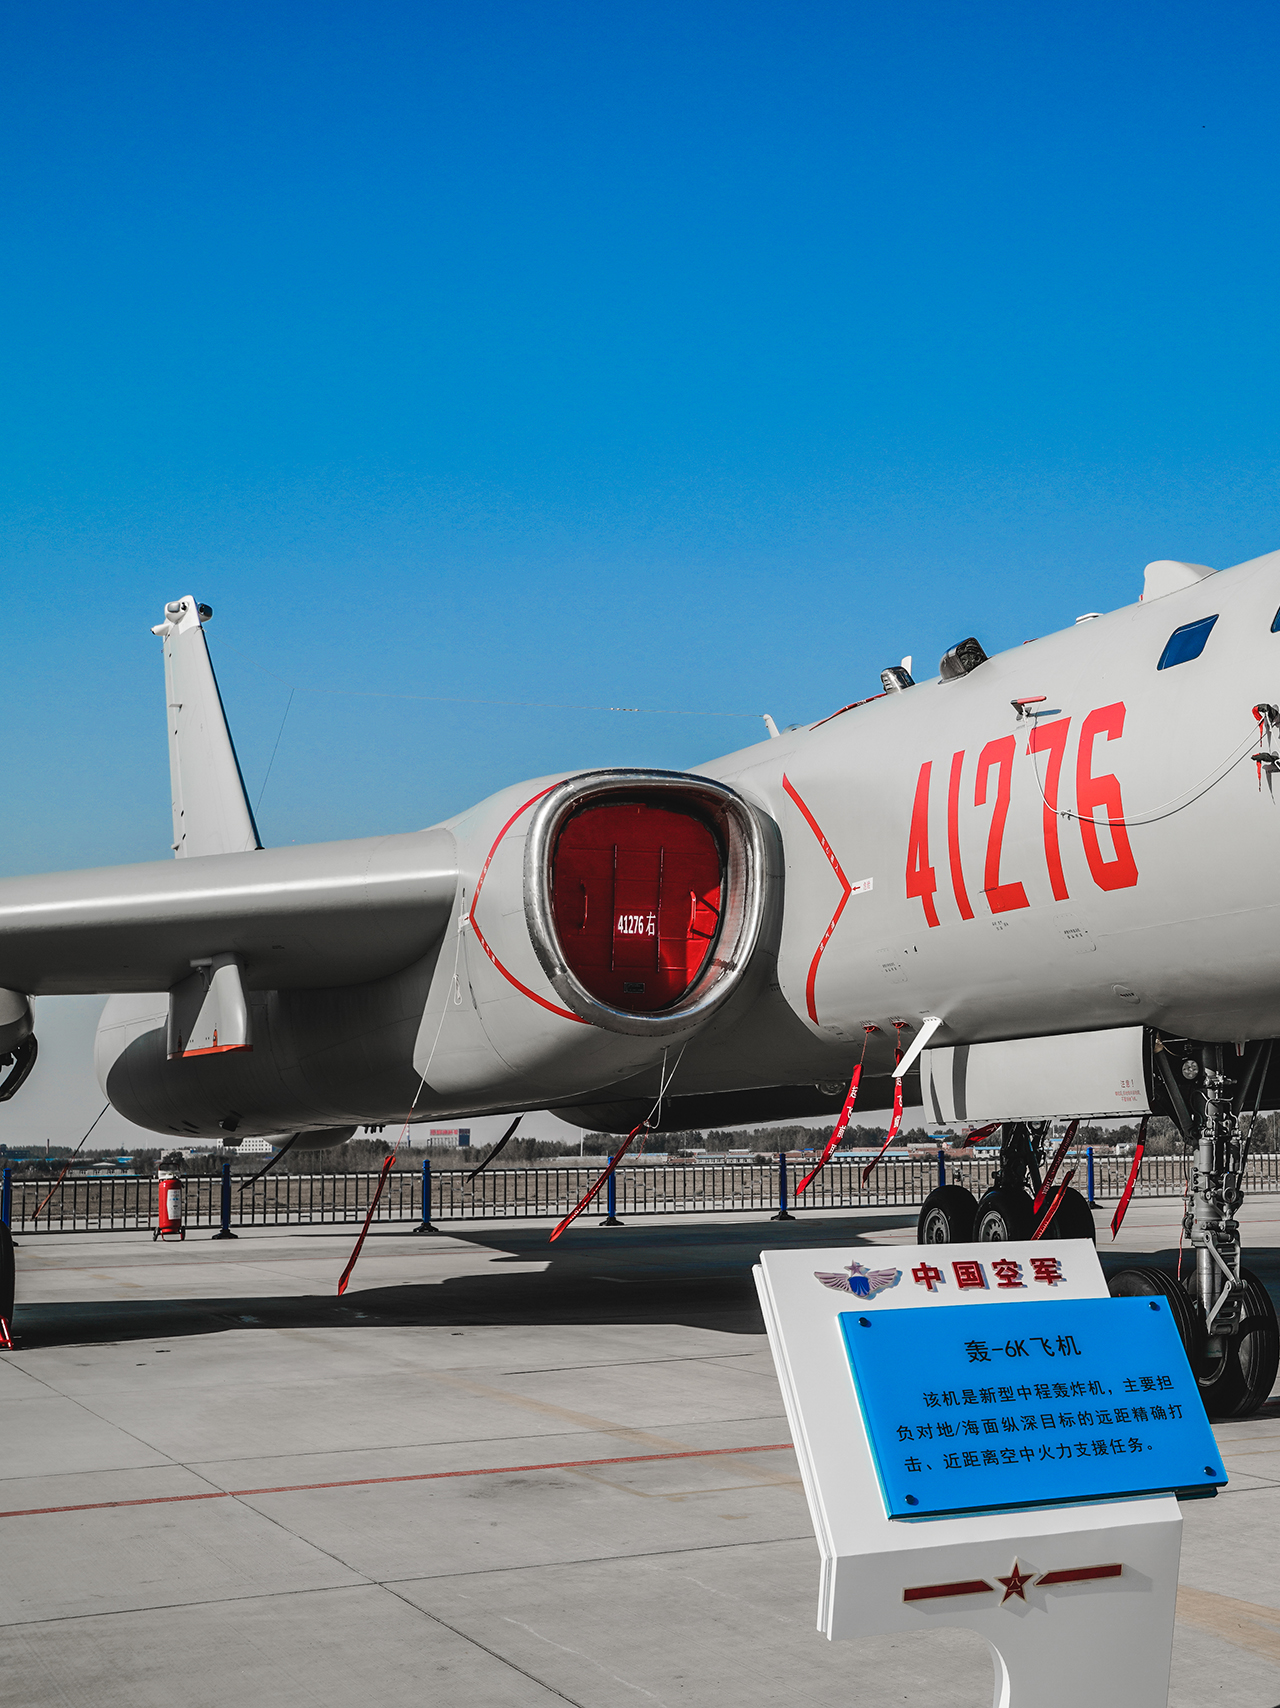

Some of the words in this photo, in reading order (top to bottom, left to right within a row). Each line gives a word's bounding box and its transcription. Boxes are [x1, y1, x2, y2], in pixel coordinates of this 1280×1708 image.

[905, 701, 1139, 928] 41276
[617, 914, 644, 935] 41276
[645, 911, 657, 936] 右
[911, 1257, 1063, 1291] 中国空军
[964, 1335, 1082, 1363] 轰-6K飞机
[922, 1374, 1175, 1408] 该机是新型中程轰炸机，主要担
[895, 1403, 1184, 1442] 负对地/海面纵深目标的远距精确打
[904, 1437, 1154, 1473] 击、近距离空中火力支援任务。
